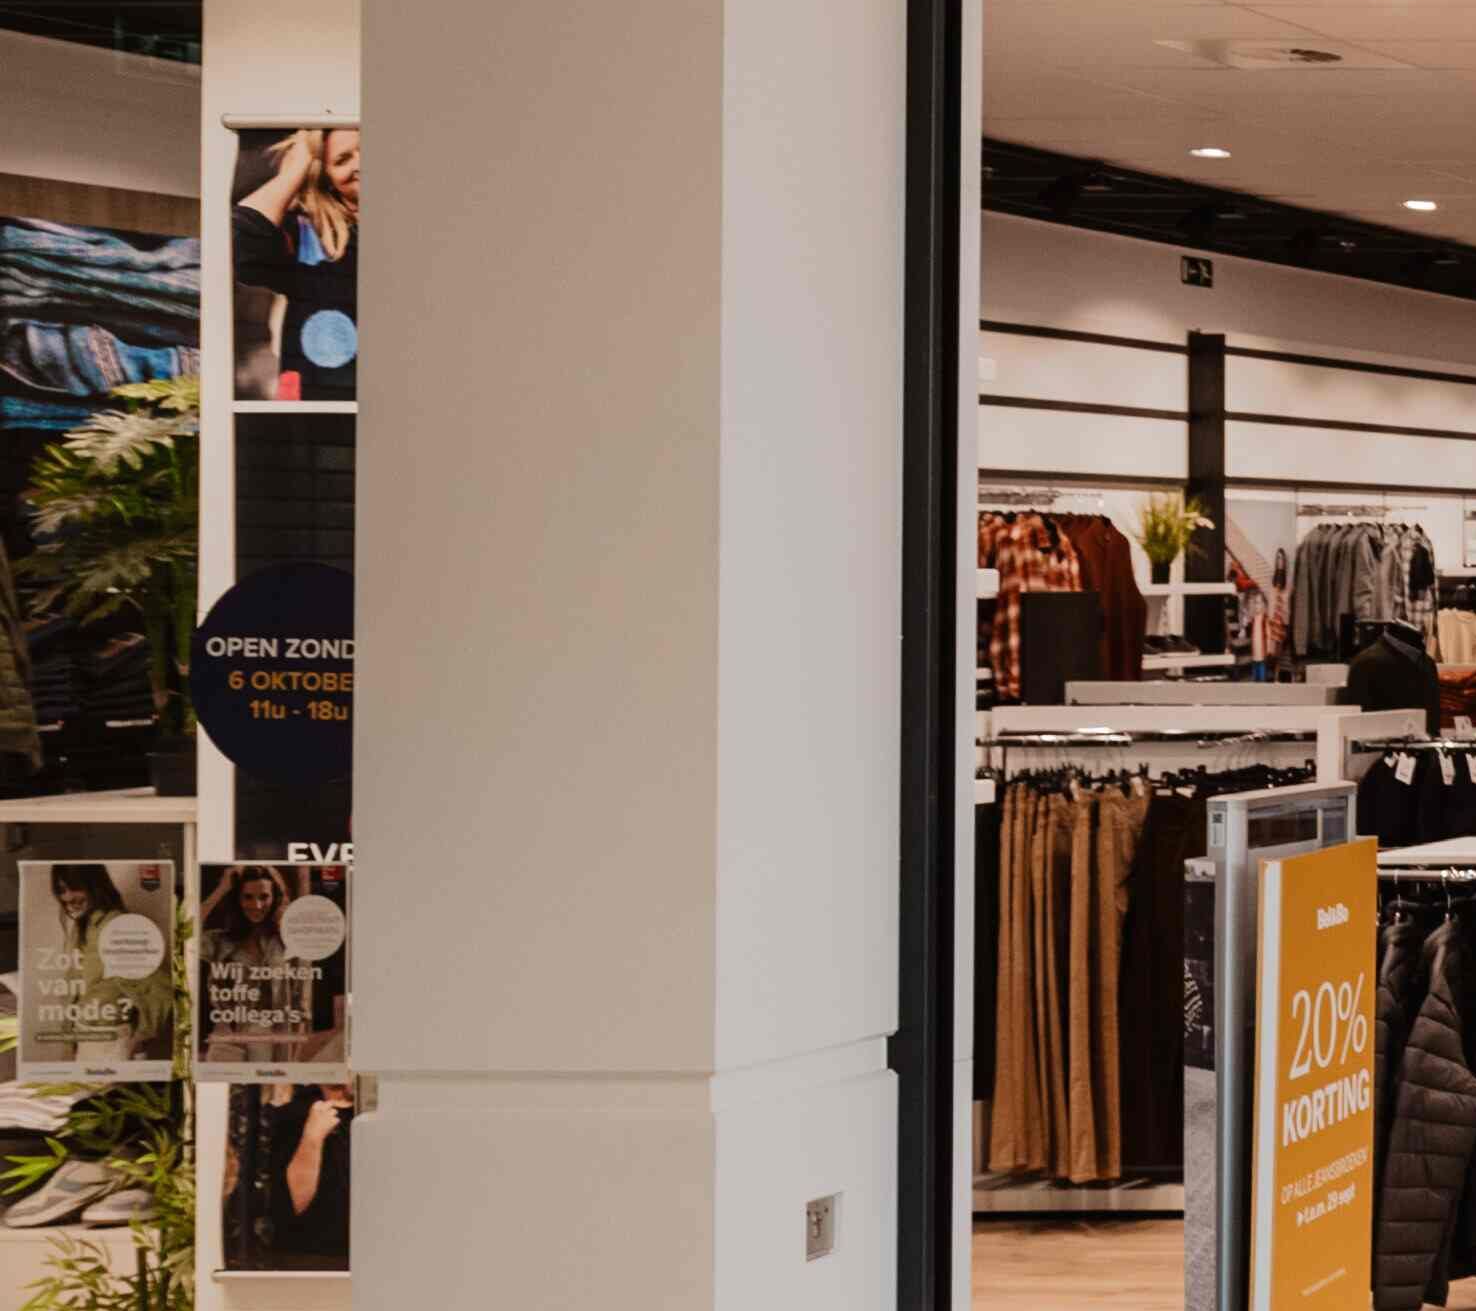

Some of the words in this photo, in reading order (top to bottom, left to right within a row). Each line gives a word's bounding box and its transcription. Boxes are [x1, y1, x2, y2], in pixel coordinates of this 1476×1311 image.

[205, 636, 279, 658] OPEN
[228, 670, 246, 690] 6
[250, 670, 354, 692] OKTOBE
[249, 699, 286, 720] 11u
[307, 700, 349, 721] 18u
[38, 947, 85, 971] Zot
[210, 962, 244, 983] Wij
[249, 962, 323, 982] zoeken
[38, 978, 87, 997] van
[209, 983, 262, 1003] toffe
[37, 997, 134, 1023] mode?
[209, 1005, 301, 1029] collega's
[1289, 971, 1368, 1081] 20%
[1282, 1067, 1371, 1148] KORTING
